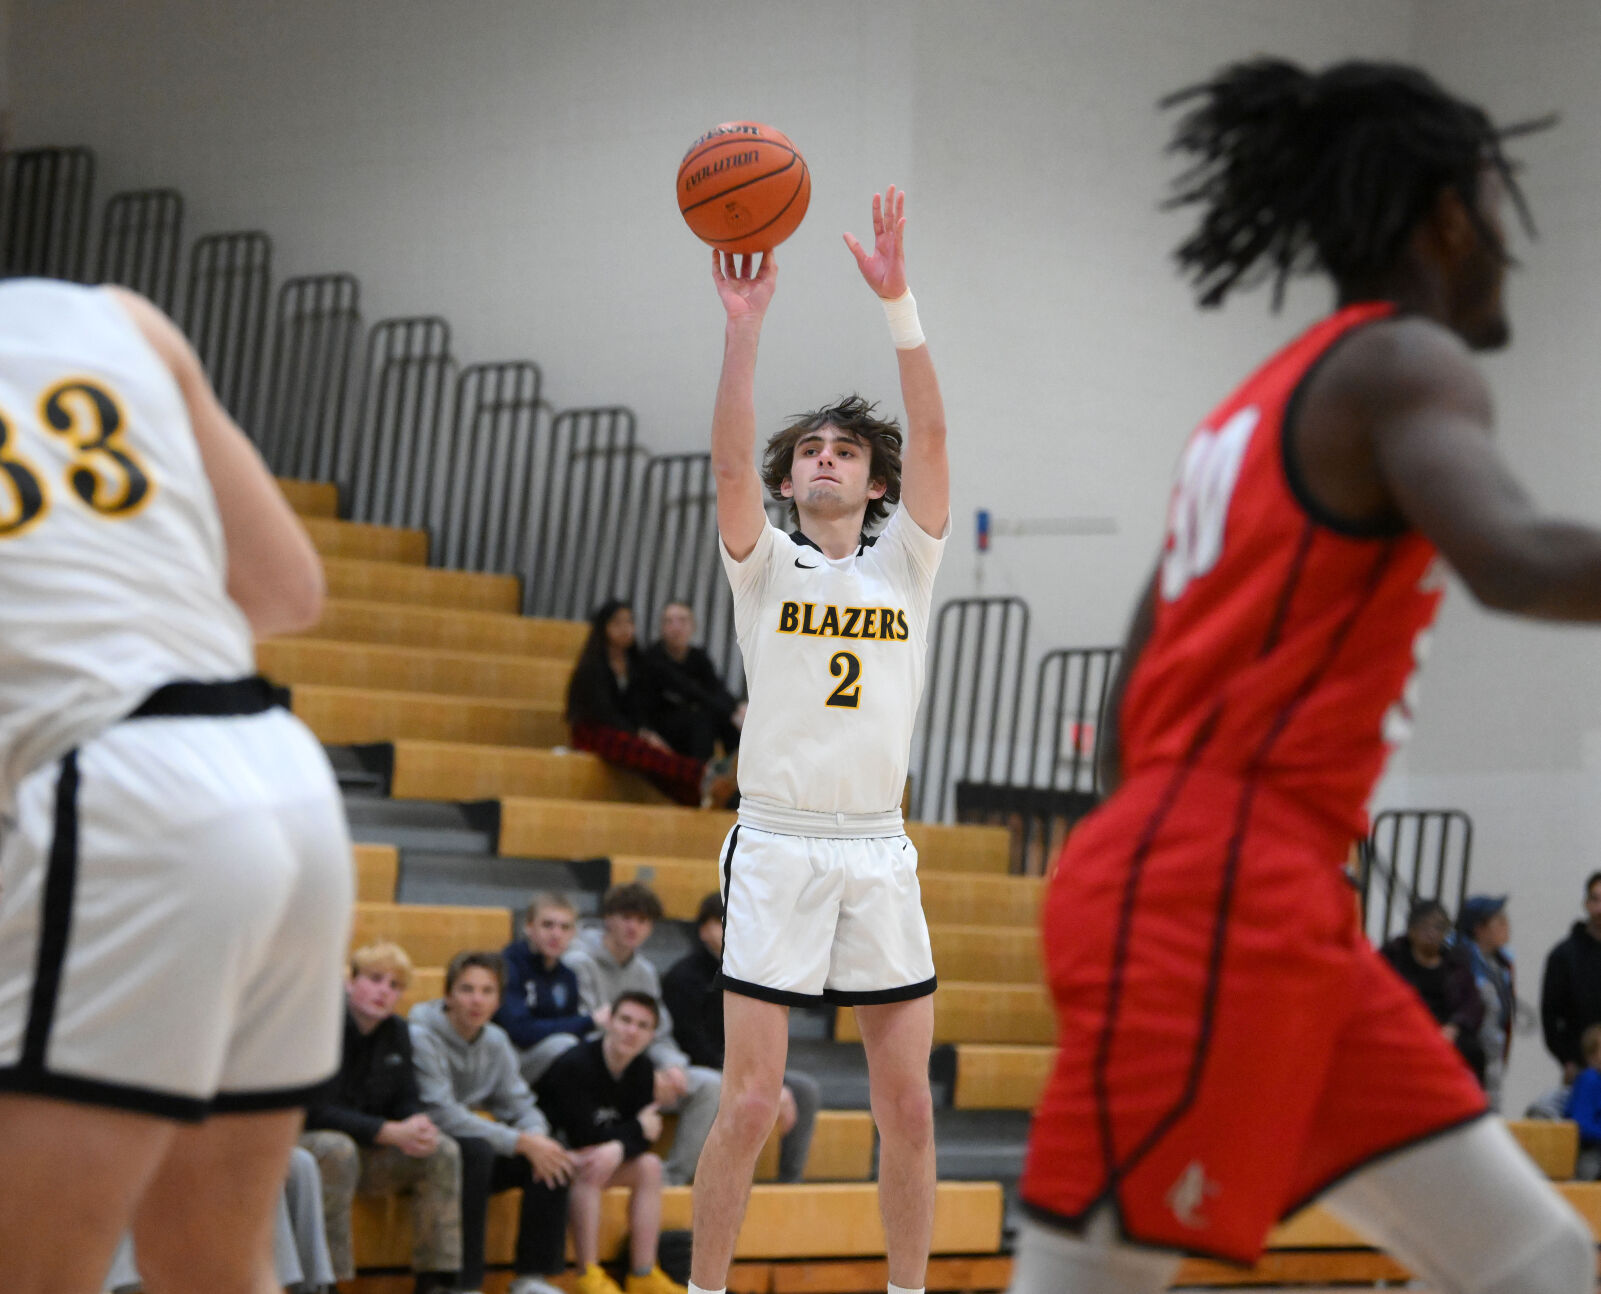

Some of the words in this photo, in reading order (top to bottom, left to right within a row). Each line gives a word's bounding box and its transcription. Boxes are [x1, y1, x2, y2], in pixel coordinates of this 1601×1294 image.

[685, 150, 759, 191] EVOLUTION
[776, 601, 909, 642] BLAZERS
[825, 650, 863, 710] 2
